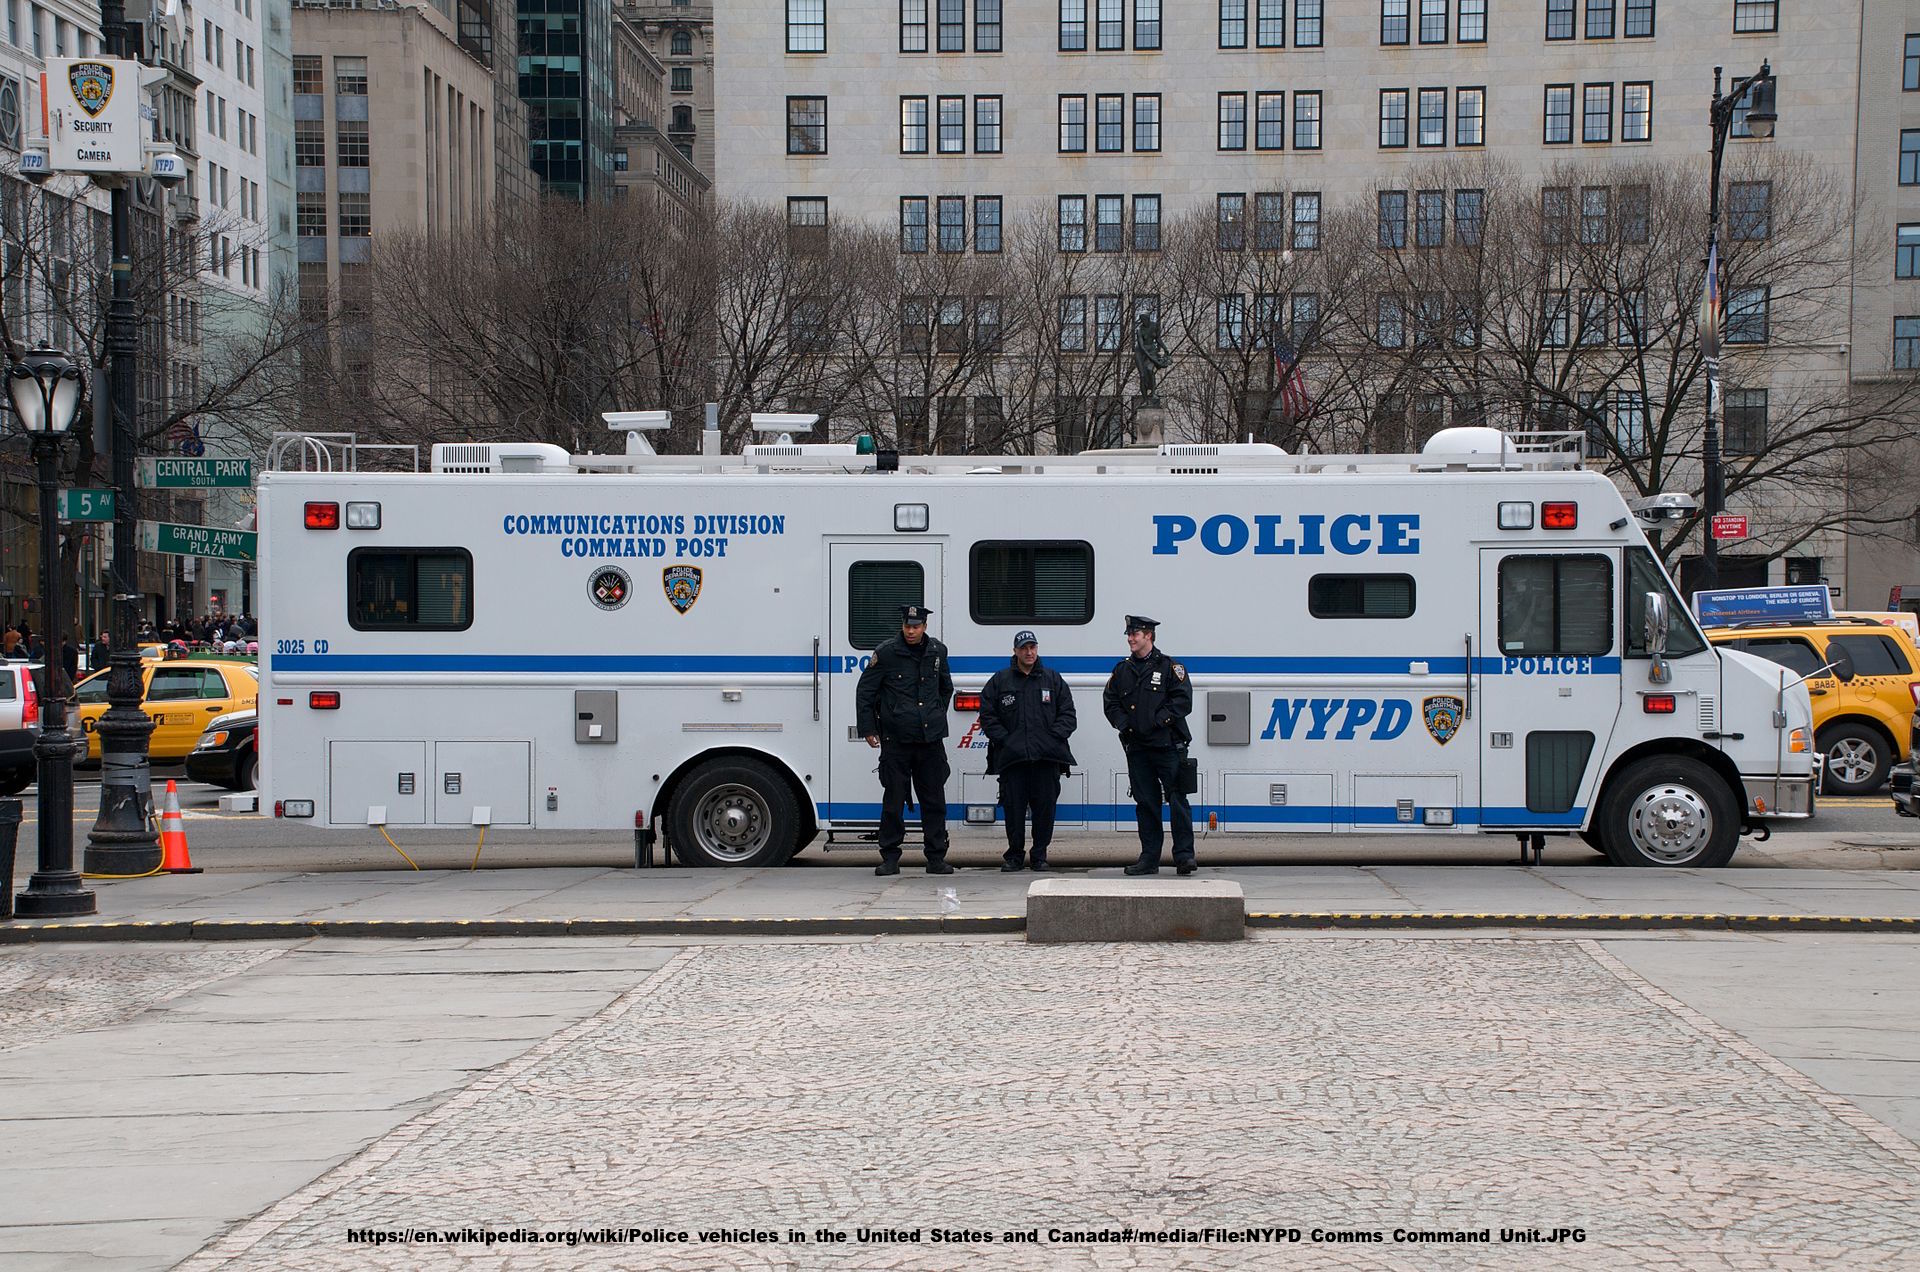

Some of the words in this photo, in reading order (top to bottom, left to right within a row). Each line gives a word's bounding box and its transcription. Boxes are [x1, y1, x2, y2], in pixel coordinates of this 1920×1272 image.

[71, 70, 112, 80] DEPARTMENT
[72, 85, 81, 98] CITY
[73, 119, 113, 133] SECURITY
[22, 155, 43, 168] NYPD
[77, 149, 112, 161] CAMERA
[154, 159, 175, 172] NYPD
[157, 460, 211, 477] CENTRAL
[215, 461, 247, 477] PARK
[191, 477, 216, 486] SOUTH
[80, 493, 92, 516] 5
[100, 493, 111, 506] AV
[503, 514, 685, 535] COMMUNICATIONS
[694, 514, 785, 535] DIVISION
[173, 527, 209, 543] GRAND
[213, 531, 244, 546] ARMY
[1151, 513, 1421, 555] POLICE
[190, 541, 225, 556] PLAZA
[561, 537, 666, 558] COMMAND
[675, 537, 728, 558] POST
[665, 572, 700, 581] DEPARTMENT
[277, 639, 305, 654] 3025
[314, 639, 329, 654] CD
[1503, 656, 1591, 675] POLICE
[1425, 703, 1462, 712] DEPARTMENT
[1260, 698, 1414, 741] NYPD
